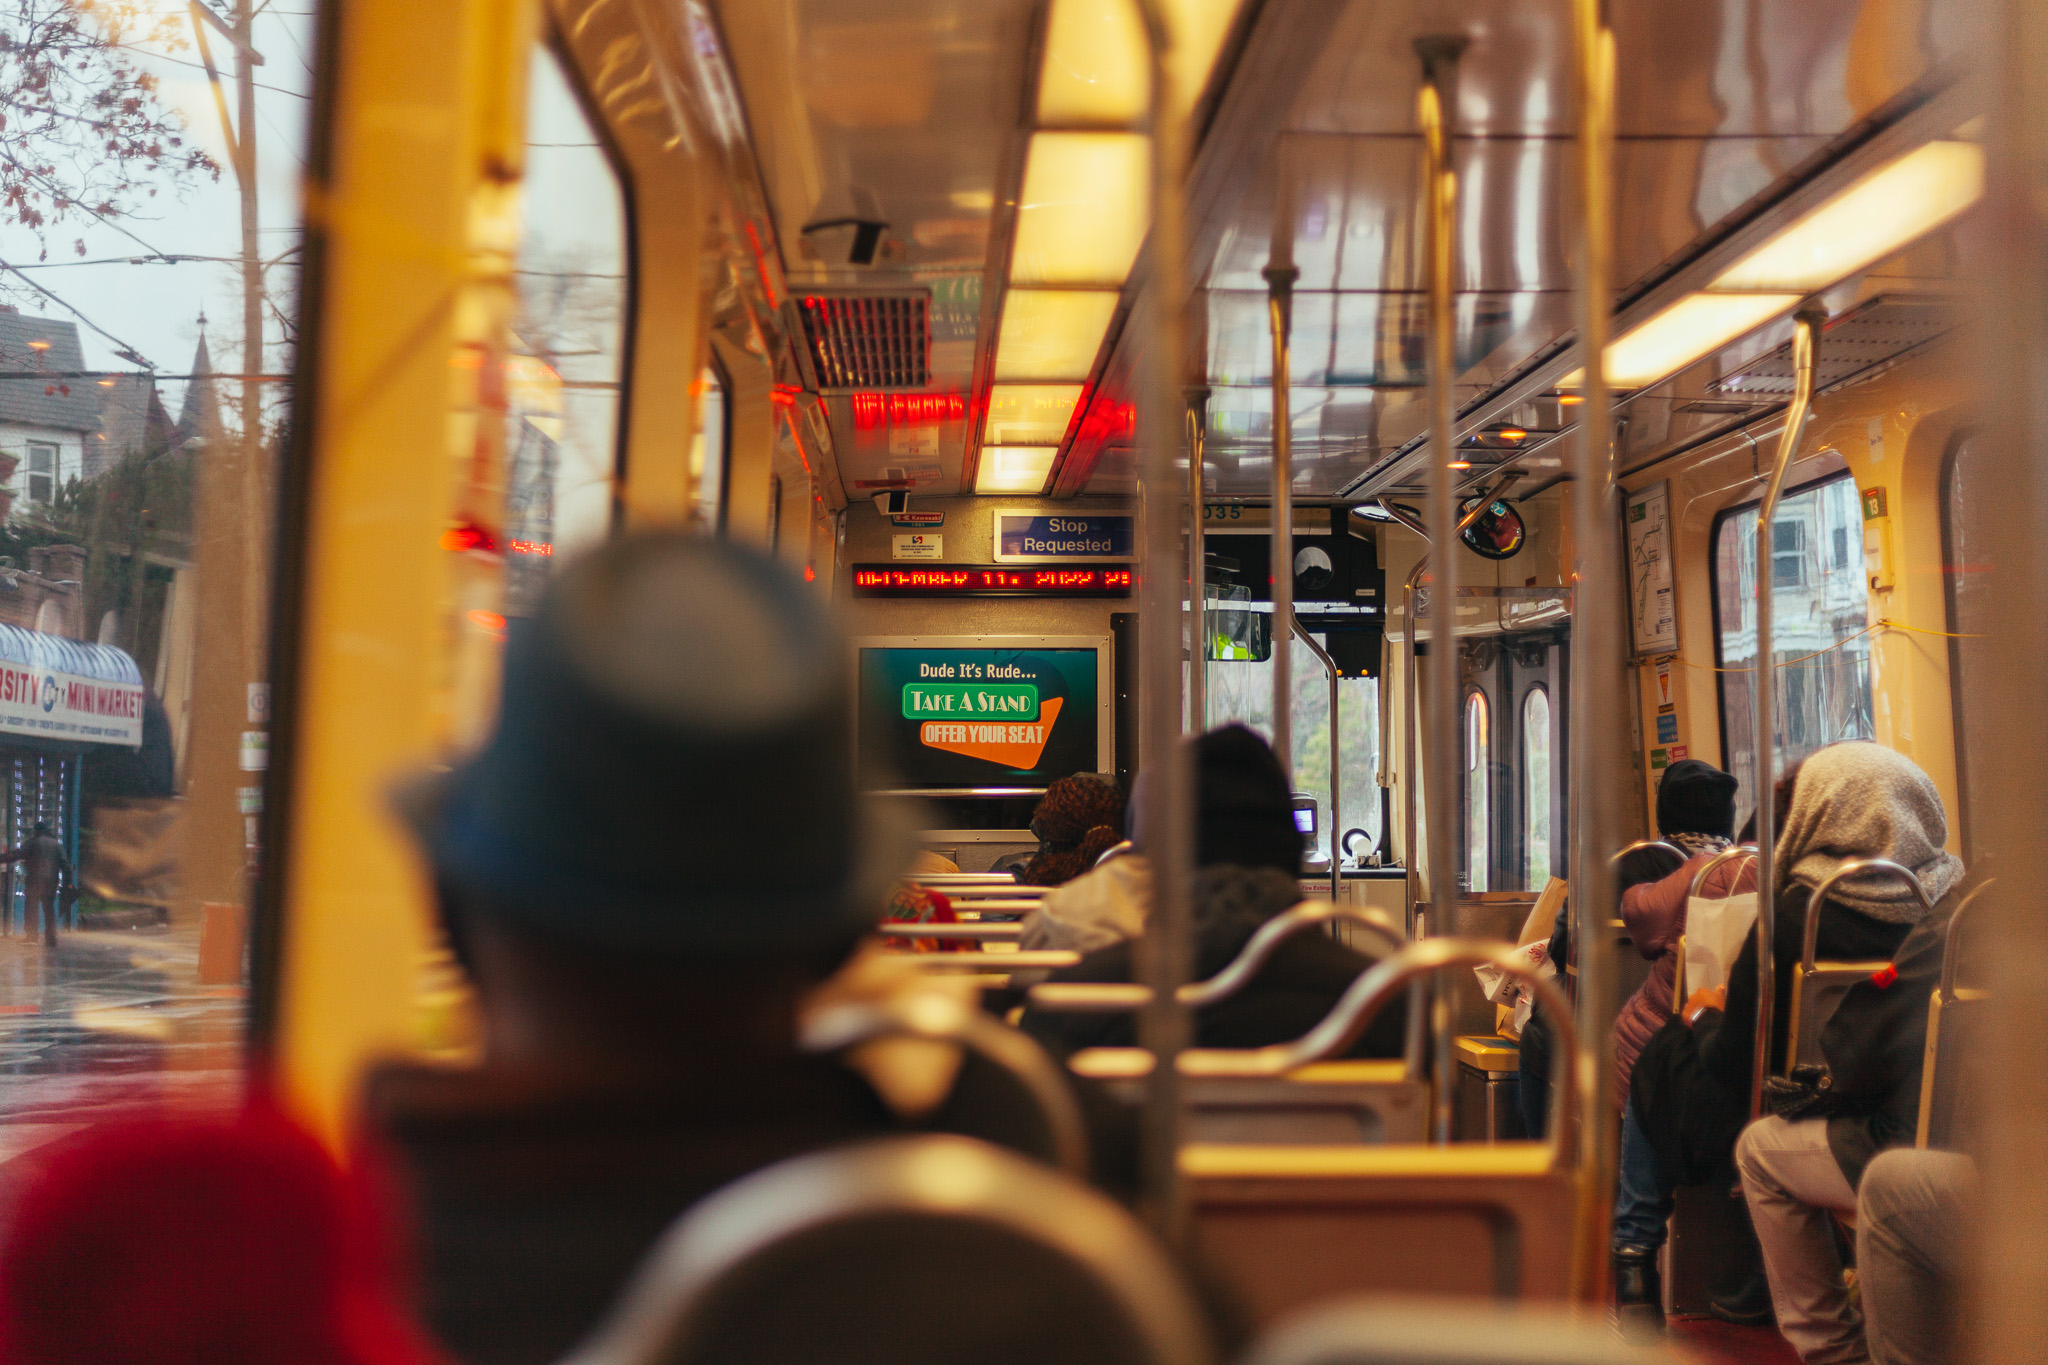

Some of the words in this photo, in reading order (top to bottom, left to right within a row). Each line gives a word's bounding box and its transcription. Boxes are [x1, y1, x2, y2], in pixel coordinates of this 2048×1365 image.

[1049, 518, 1088, 534] Stop
[1024, 538, 1112, 554] Requested
[920, 663, 955, 678] Dude
[959, 663, 982, 678] It's
[987, 663, 1036, 679] Rude...
[66, 681, 95, 714] MINI
[97, 687, 142, 718] MARKET
[911, 691, 955, 711] TAKE
[959, 692, 973, 711] A
[977, 691, 1031, 712] STAND
[925, 724, 967, 743] OFFER
[969, 725, 1007, 743] YOUR
[1008, 725, 1044, 744] SEAT
